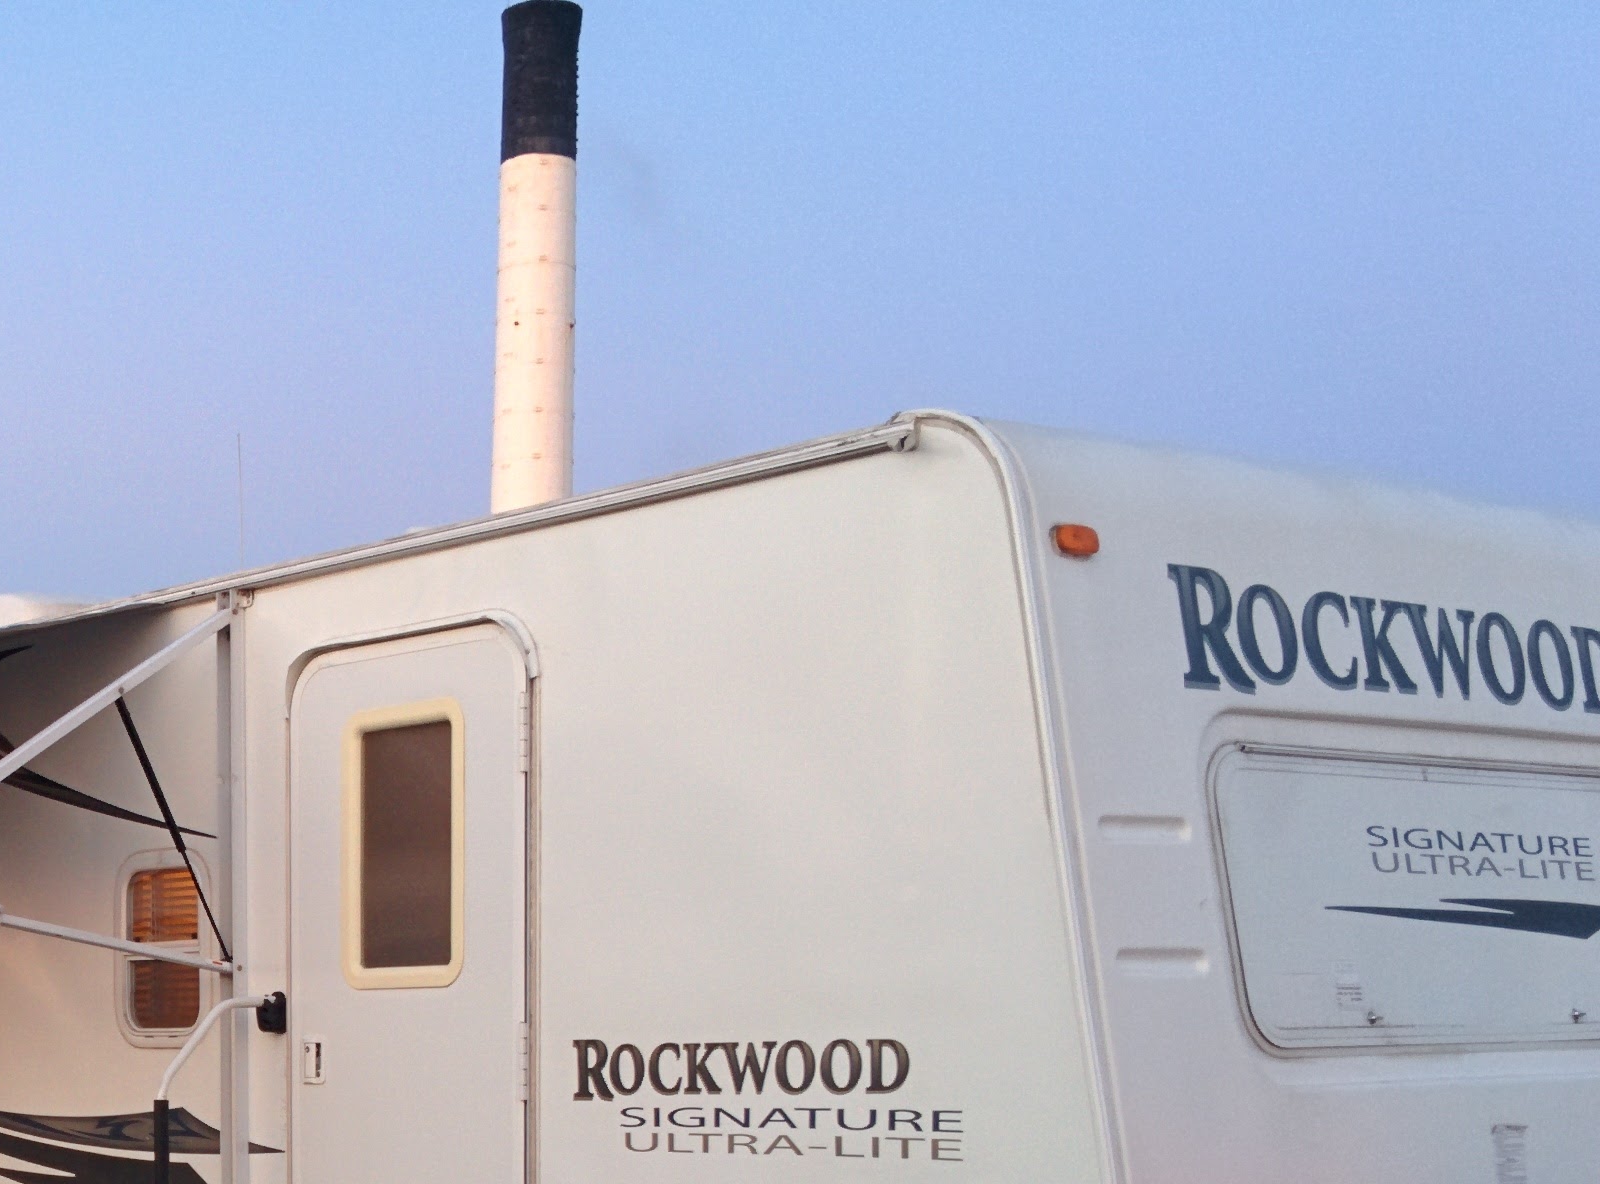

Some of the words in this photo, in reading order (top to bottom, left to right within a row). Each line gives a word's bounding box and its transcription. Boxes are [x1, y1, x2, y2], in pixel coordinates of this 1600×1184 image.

[1366, 825, 1594, 857] SIGNATURE
[1372, 853, 1596, 882] ULTRA-LITE
[572, 1039, 910, 1102] ROCKWOOD
[619, 1107, 964, 1133] SIGNATURE
[624, 1132, 964, 1161] ULTRA-LITE
